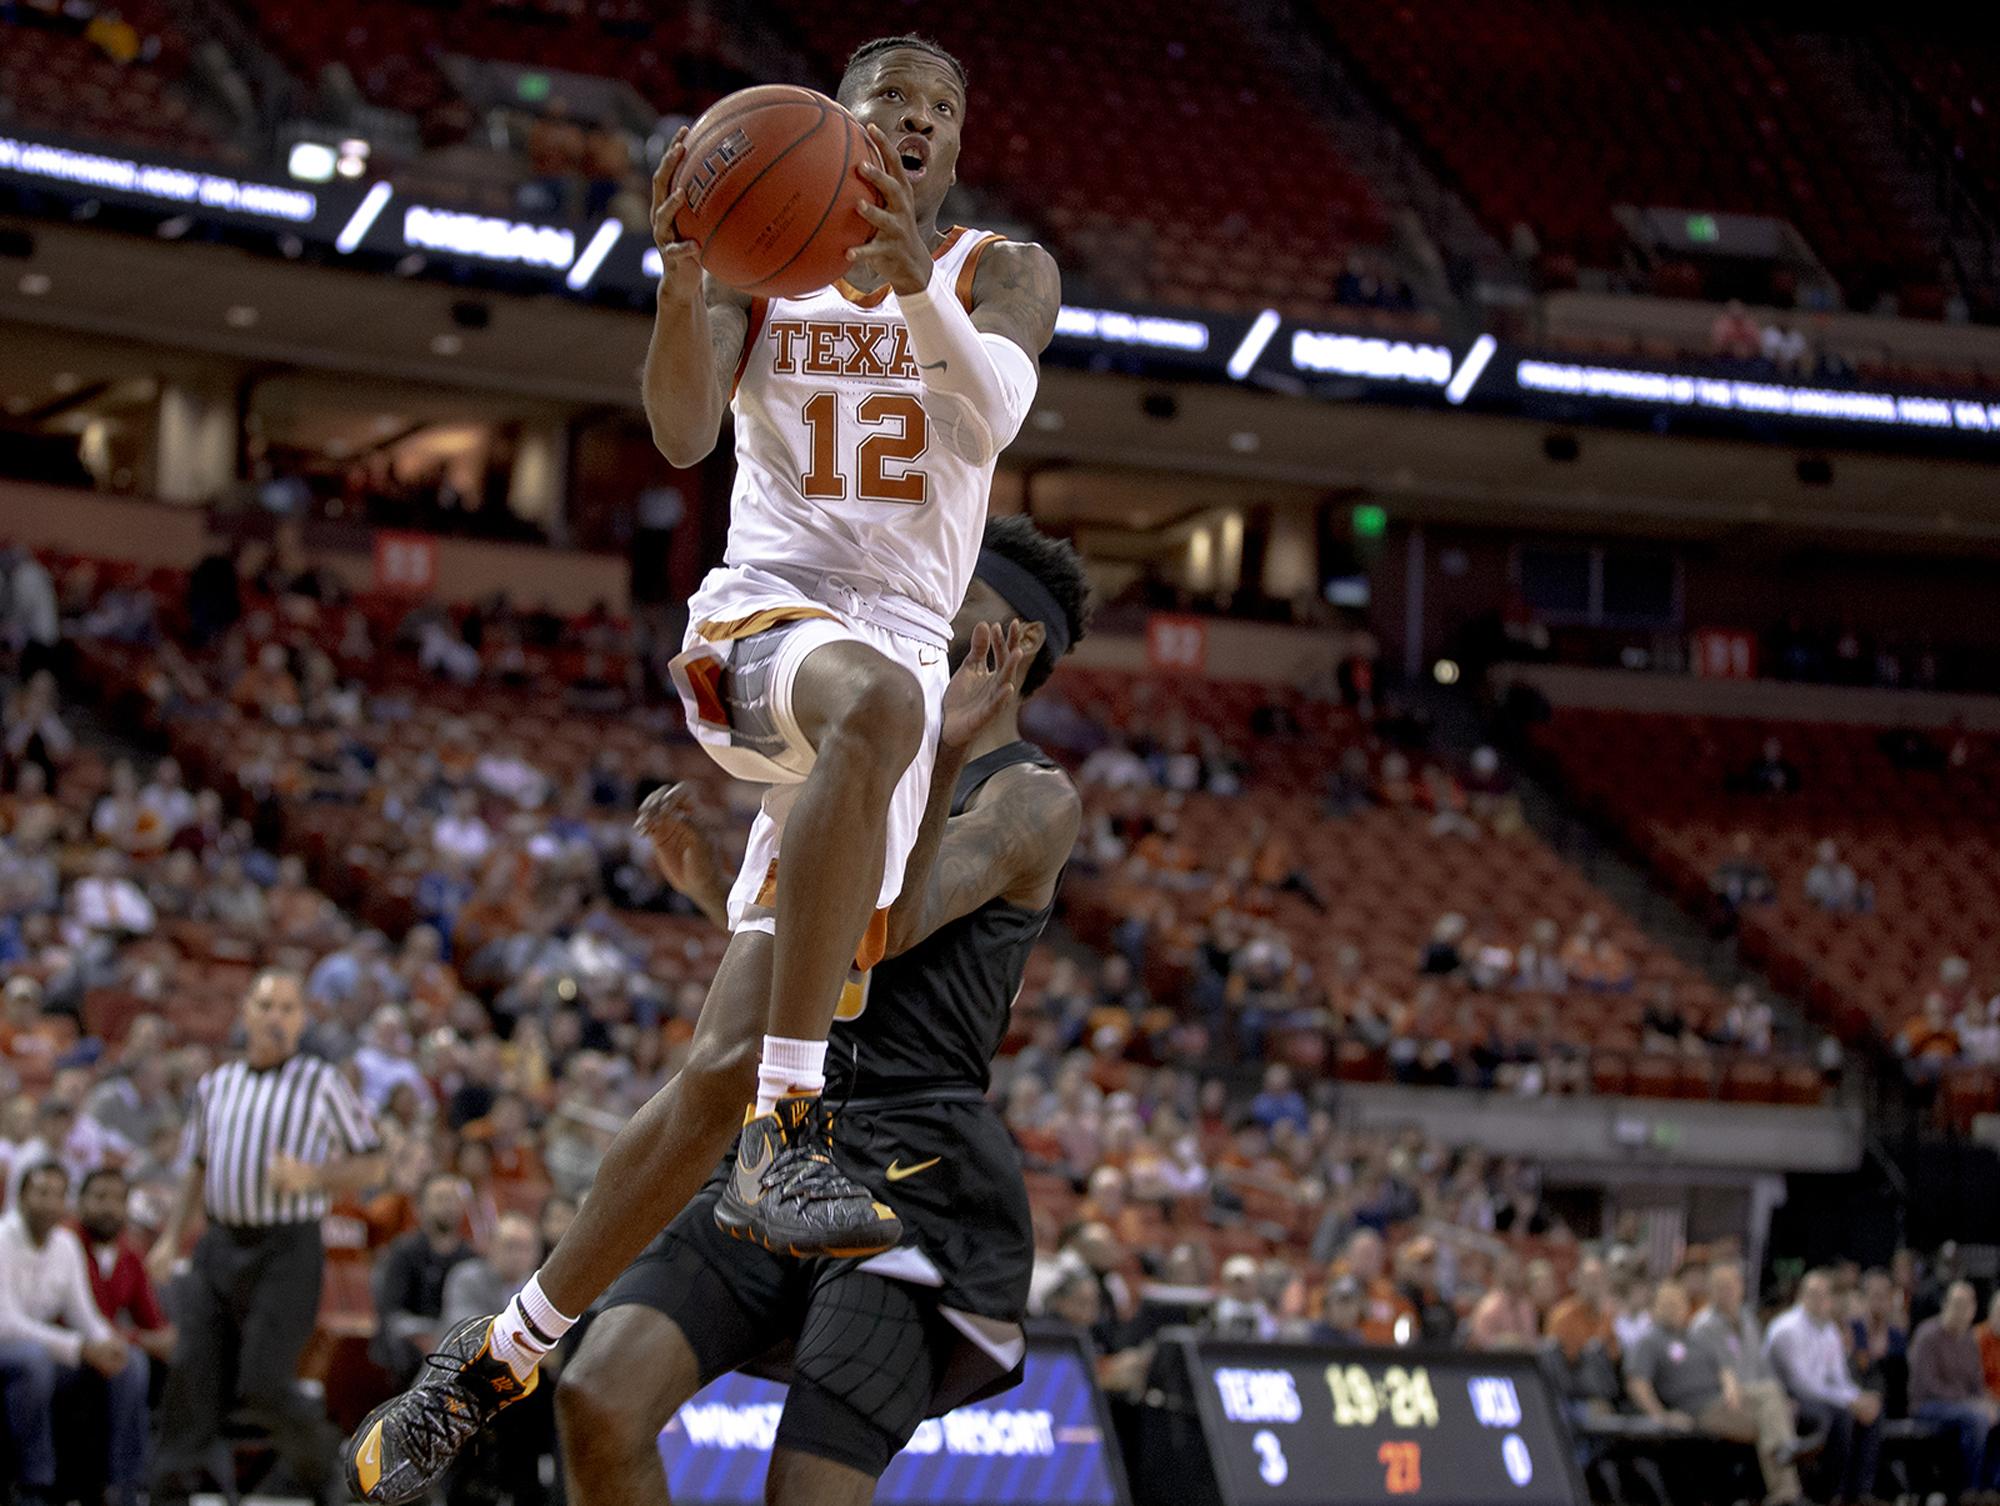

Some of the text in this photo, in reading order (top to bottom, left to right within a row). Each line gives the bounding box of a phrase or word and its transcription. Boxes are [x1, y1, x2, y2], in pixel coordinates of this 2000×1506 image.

[769, 320, 921, 380] TEXA
[801, 391, 930, 505] 12
[1325, 1363, 1440, 1428] 19:24
[1252, 1429, 1288, 1486] 3
